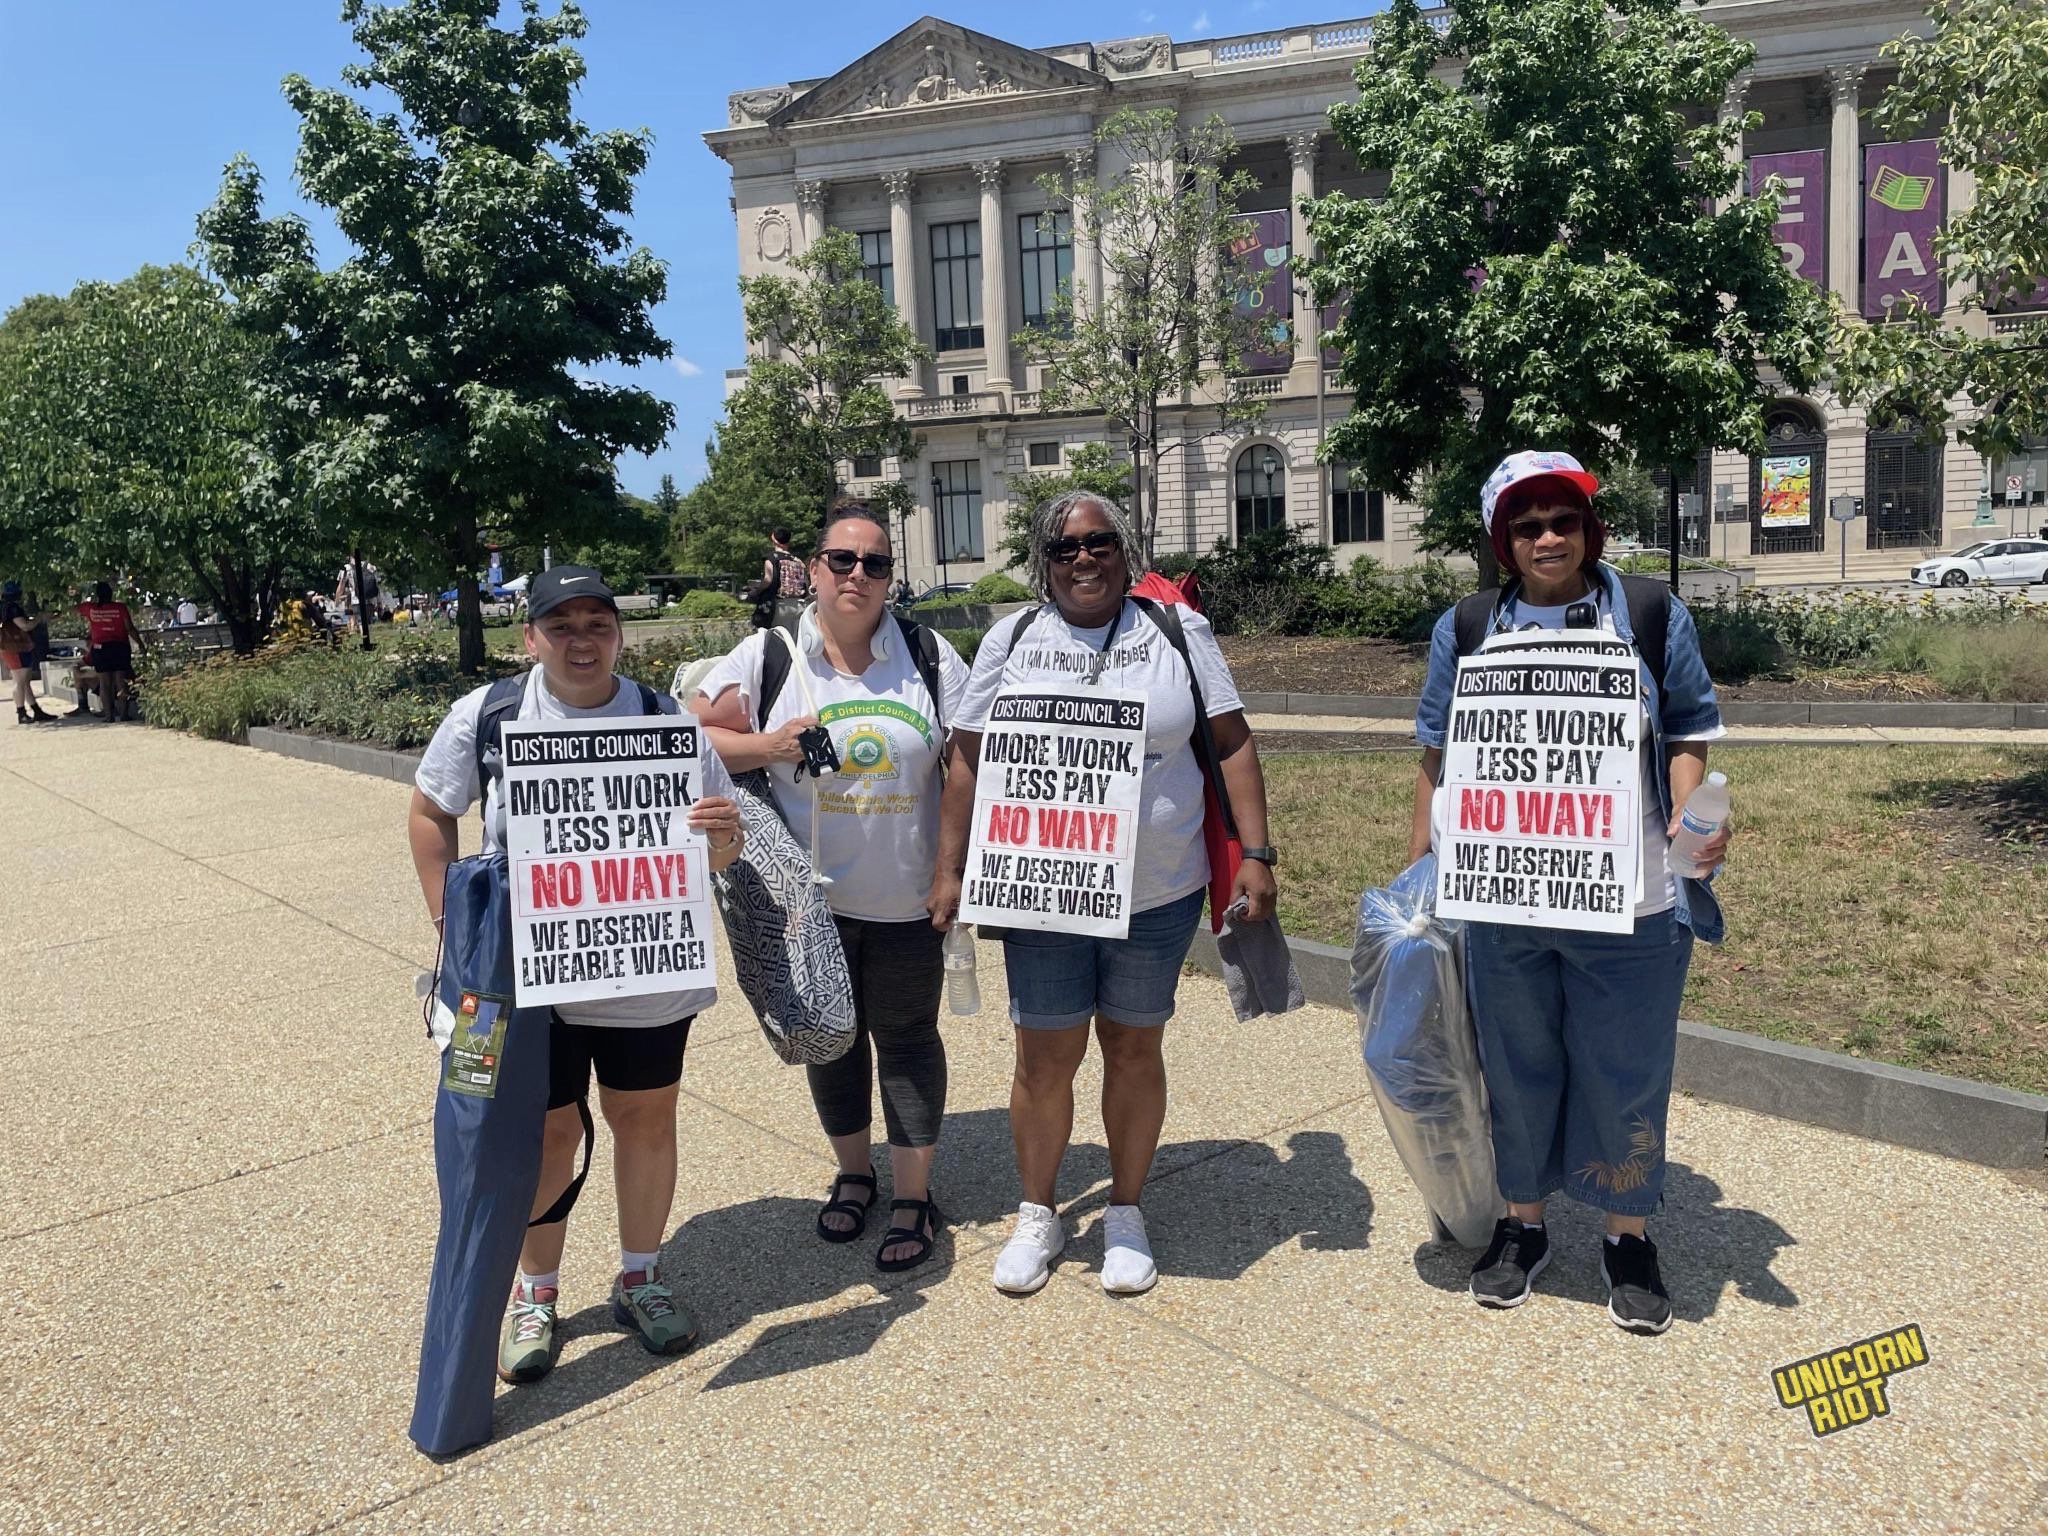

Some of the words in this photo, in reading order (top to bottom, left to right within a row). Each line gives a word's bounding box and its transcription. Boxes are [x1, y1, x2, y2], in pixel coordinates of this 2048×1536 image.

[1878, 232, 1927, 279] A
[1021, 651, 1025, 669] I
[1027, 650, 1042, 669] AM
[1043, 651, 1050, 670] A
[1053, 651, 1086, 673] PROUD
[1114, 643, 1151, 669] MEMBER
[1461, 670, 1527, 693] DISTRICT
[1532, 670, 1605, 694] COUNCIL
[1609, 674, 1632, 695] 33
[838, 706, 875, 717] District
[878, 705, 916, 723] Council
[995, 698, 1052, 720] DISTRICT
[1055, 700, 1115, 724] COUNCIL
[1121, 706, 1140, 726] 33
[1453, 709, 1527, 743] MORE
[1537, 710, 1634, 751] WORK,
[511, 736, 590, 762] DISTRICT
[595, 733, 667, 757] COUNCIL
[671, 732, 693, 754] 33
[984, 732, 1050, 766] MORE
[1057, 736, 1138, 776] WORK,
[1476, 747, 1537, 782] LESS
[1546, 749, 1603, 785] PAY
[510, 776, 595, 816] MORE
[1005, 767, 1056, 801] LESS
[1063, 773, 1111, 804] PAY
[988, 805, 1030, 844] NO
[1038, 809, 1117, 851] WAY!
[1460, 788, 1506, 832] NO
[1517, 791, 1612, 837] WAY!
[544, 813, 610, 854] LESS
[619, 812, 671, 849] PAY
[531, 860, 583, 909] NO
[591, 854, 687, 903] WAY!
[982, 853, 1012, 879] WE
[1016, 857, 1096, 889] DESERVE
[1102, 863, 1114, 890] A
[1456, 842, 1488, 871] WE
[1496, 845, 1592, 878] DESERVE
[1600, 851, 1615, 881] A
[968, 880, 1051, 912] LIVEABLE
[1058, 888, 1122, 919] WAGE!
[1444, 873, 1539, 908] LIVEABLE
[1548, 880, 1624, 913] WAGE!
[530, 920, 569, 952] WE
[576, 911, 674, 948] DESERVE
[680, 910, 695, 939] A
[522, 949, 625, 987] LIVEABLE
[631, 941, 706, 976] WAGE!
